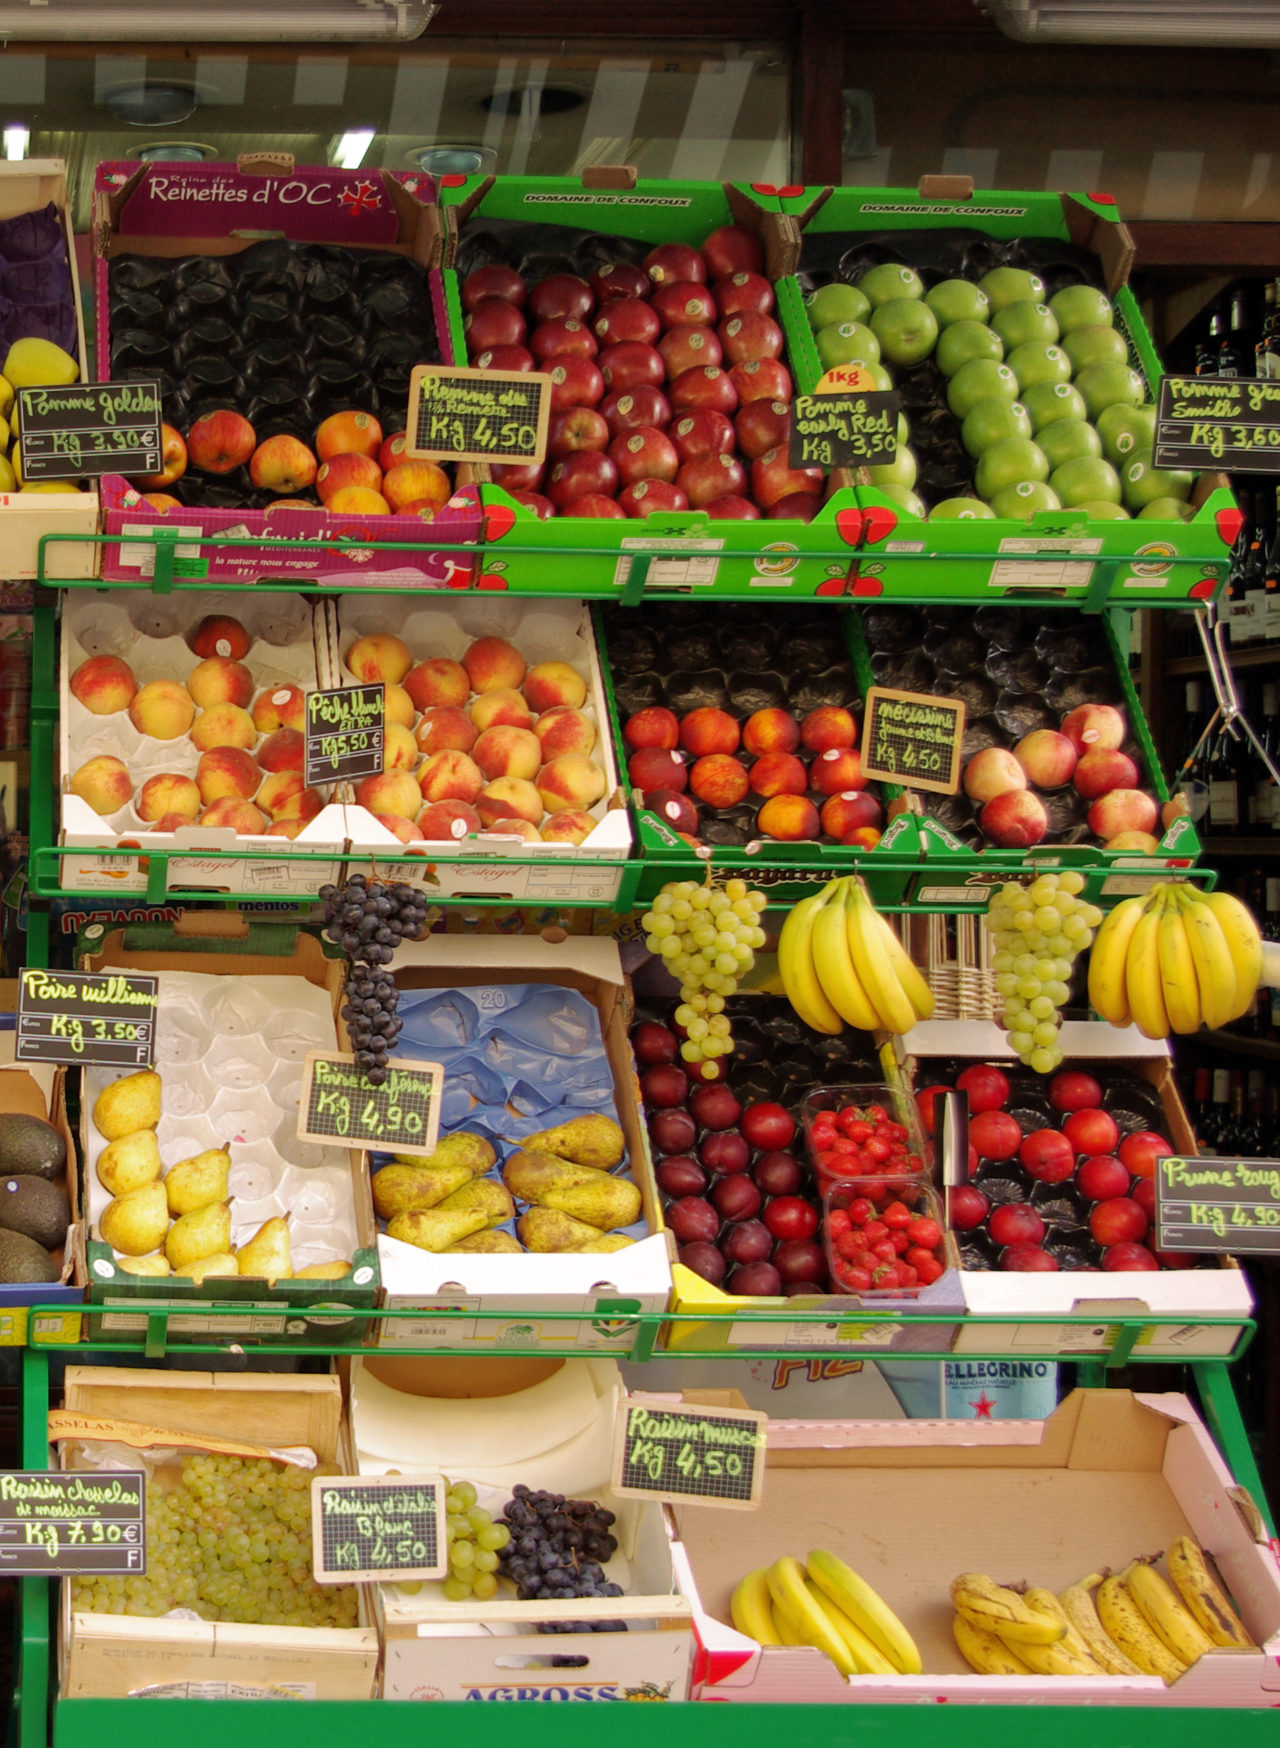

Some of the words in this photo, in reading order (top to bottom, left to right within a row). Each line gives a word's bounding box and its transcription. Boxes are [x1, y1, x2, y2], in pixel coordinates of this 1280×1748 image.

[148, 177, 248, 203] Reinettes
[252, 180, 332, 205] d'OC
[524, 193, 595, 204] DOMAINE
[597, 194, 617, 204] DE
[619, 196, 690, 207] CONFOUX
[860, 203, 931, 214] DOMAINE
[933, 204, 953, 215] DE
[955, 206, 1026, 217] CONFOUX
[827, 370, 859, 386] 1kg
[1170, 378, 1241, 398] Pomme
[22, 389, 96, 417] Pomme
[796, 396, 867, 419] Pomme
[473, 418, 536, 449] 4,50
[850, 410, 893, 433] Red
[850, 434, 897, 458] 3,50
[215, 556, 224, 565] la
[226, 558, 256, 567] nature
[260, 559, 283, 567] nous
[285, 559, 320, 571] engage
[22, 970, 78, 999] Poire
[481, 989, 508, 1009] 20
[361, 1100, 422, 1135] 4,90
[1162, 1157, 1235, 1188] Prune
[675, 1442, 742, 1479] 4,50
[371, 1536, 426, 1566] 4,50
